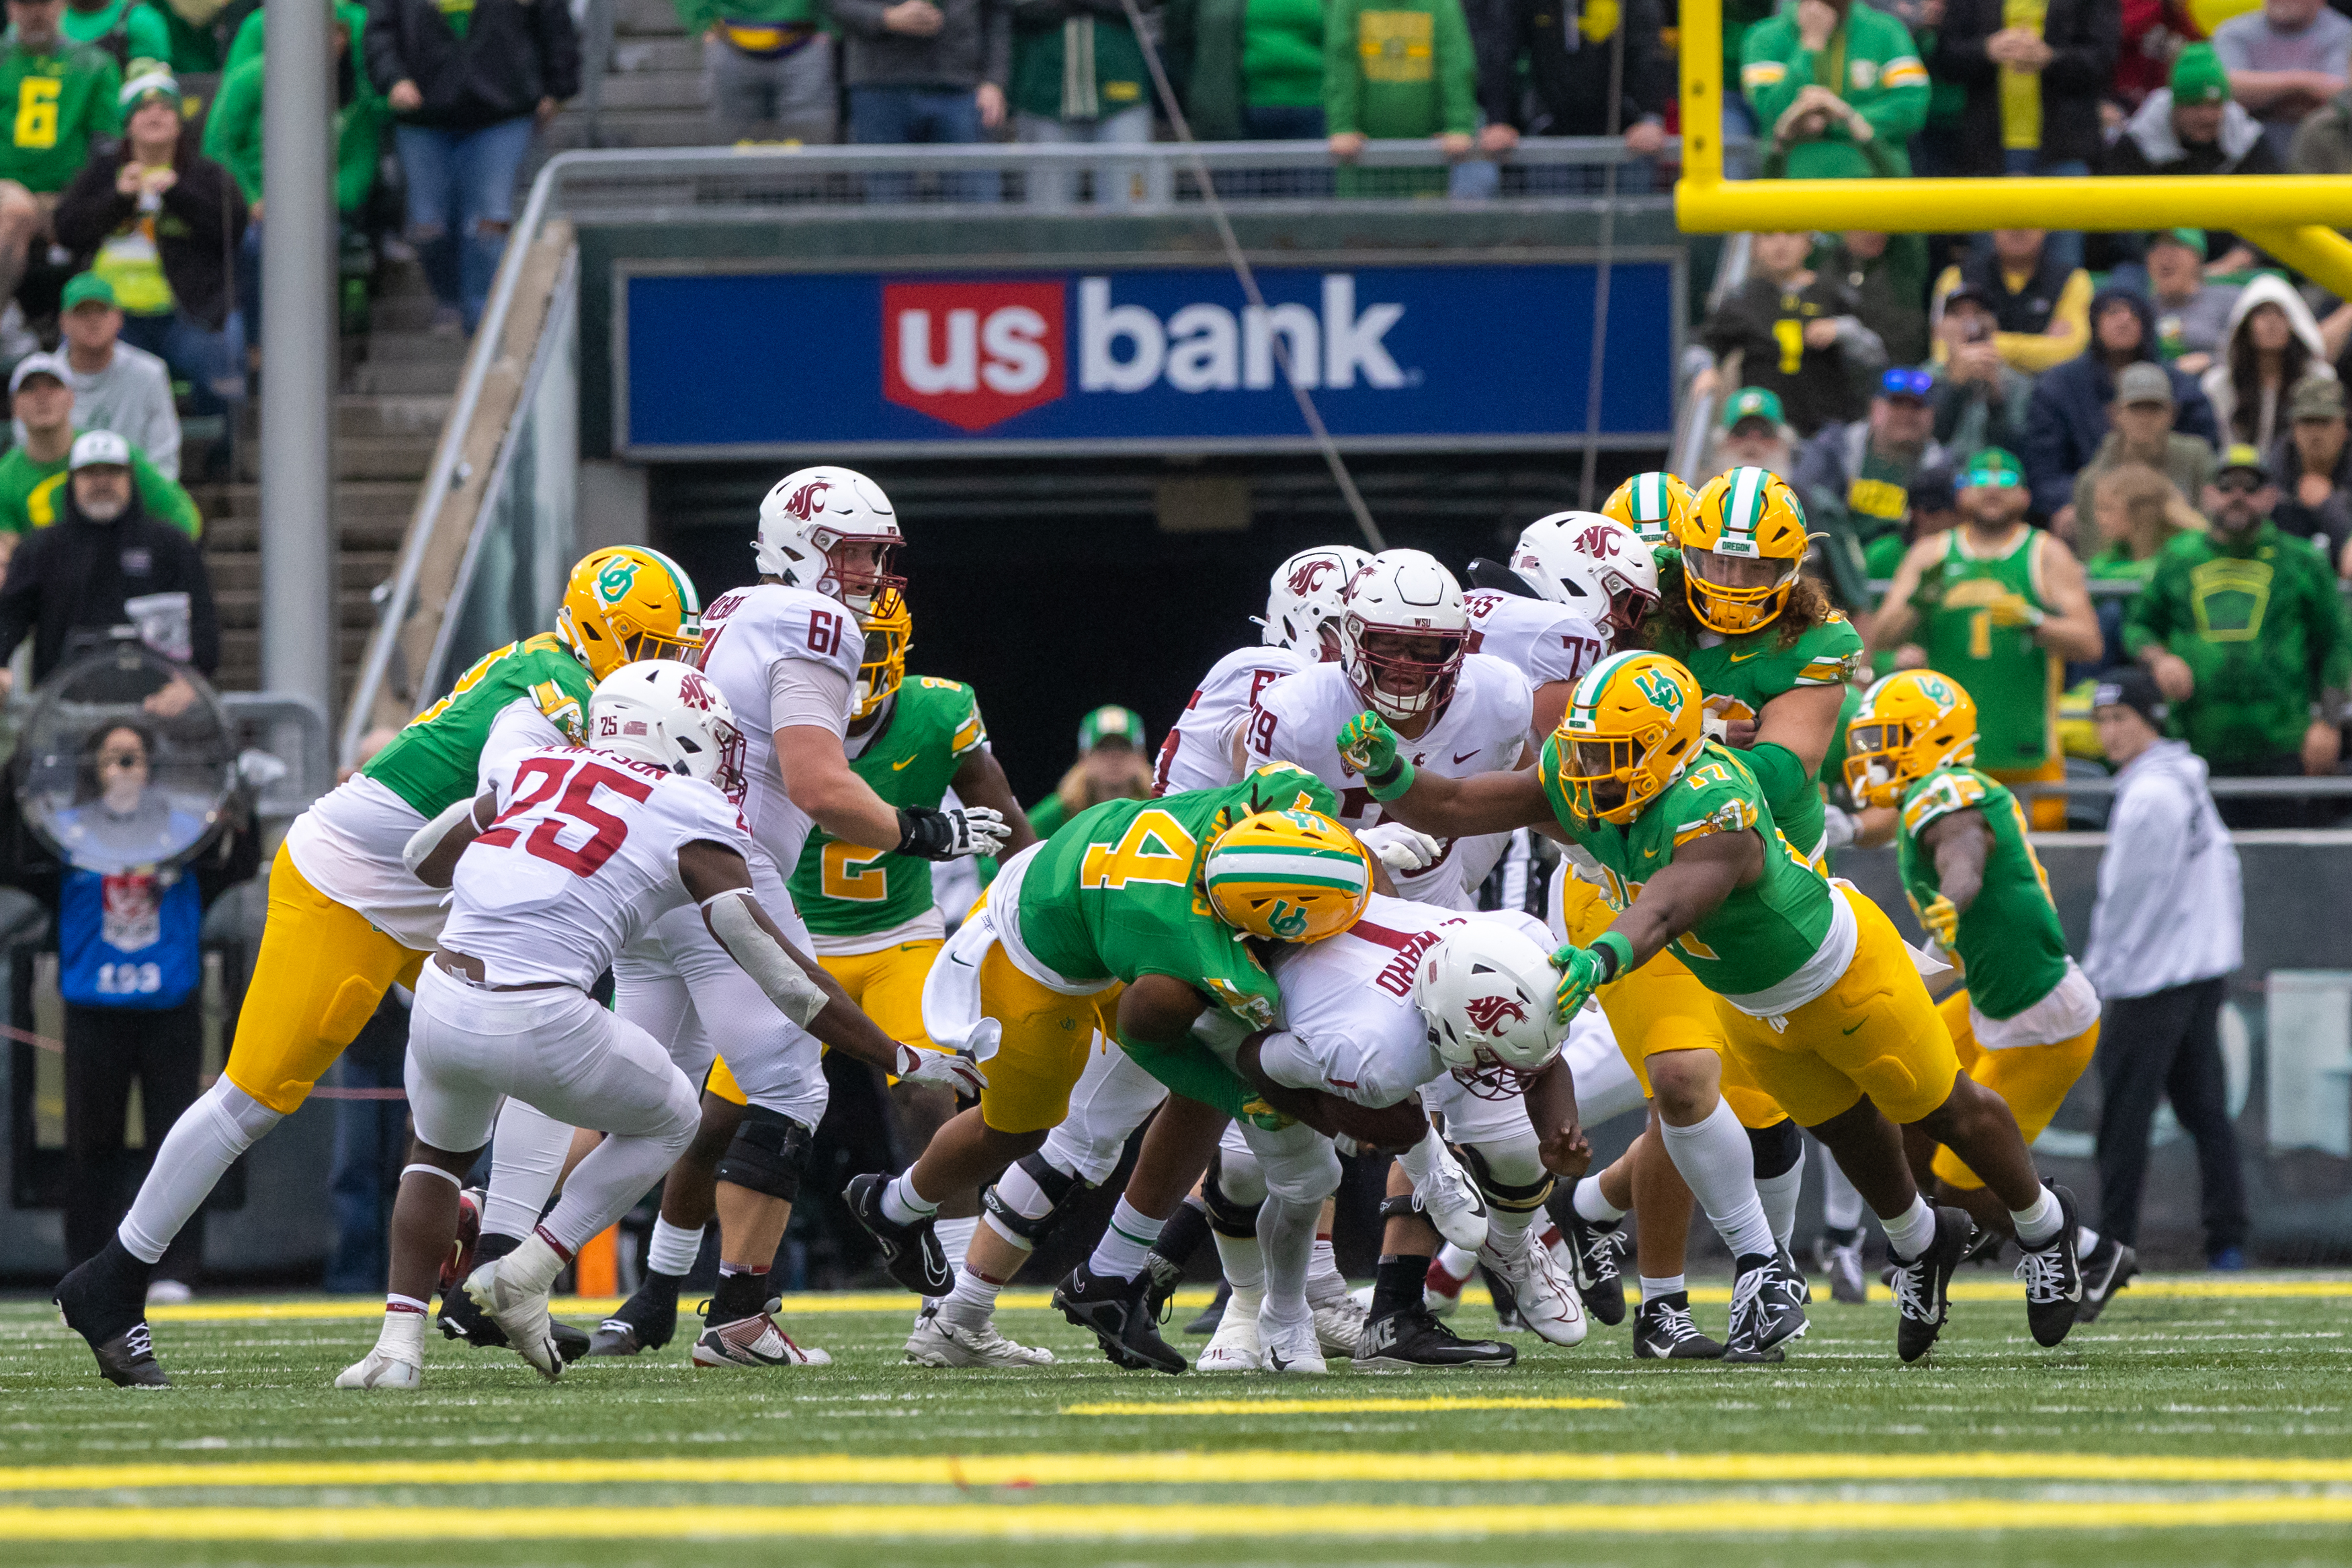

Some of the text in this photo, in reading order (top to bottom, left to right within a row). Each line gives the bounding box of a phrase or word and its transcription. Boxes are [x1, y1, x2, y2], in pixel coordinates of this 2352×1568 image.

[13, 77, 62, 148] 6
[898, 275, 1406, 395] us bank
[1722, 540, 1751, 553] OREGON
[807, 609, 843, 656] 61
[1415, 617, 1431, 627] WSU
[1561, 636, 1601, 679] 77
[600, 715, 617, 736] 25
[1246, 701, 1278, 757] 79
[1686, 763, 1732, 791] 17
[470, 757, 655, 878] 25
[821, 840, 888, 902] 2
[1081, 809, 1197, 890] 4
[538, 1227, 557, 1244] GRIP
